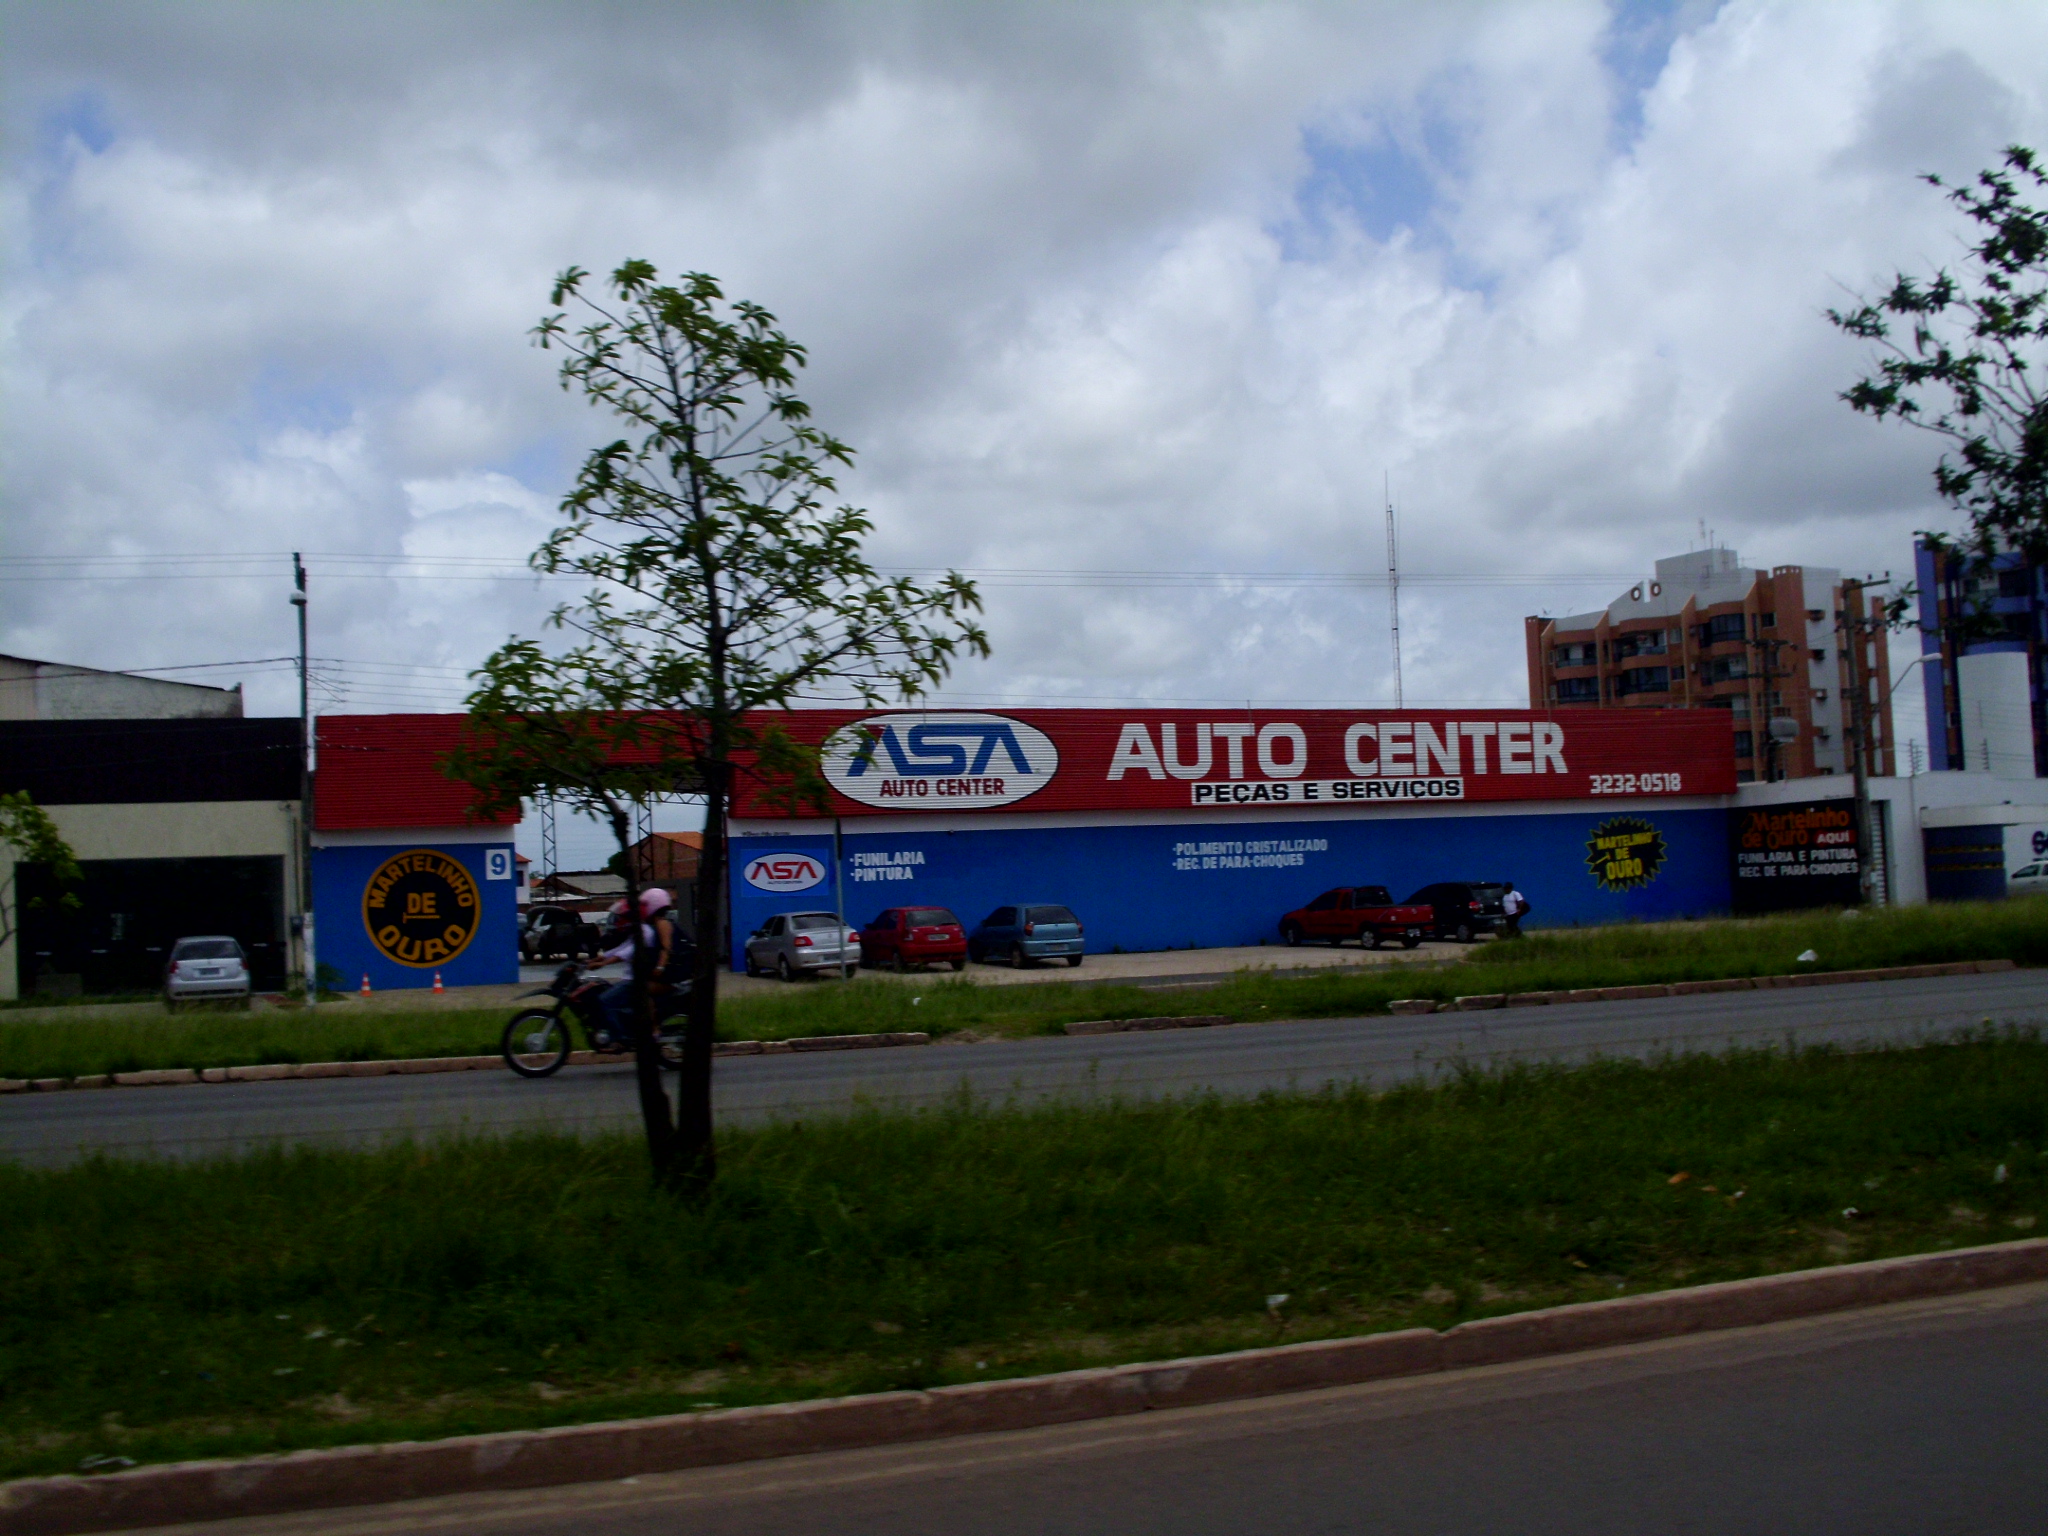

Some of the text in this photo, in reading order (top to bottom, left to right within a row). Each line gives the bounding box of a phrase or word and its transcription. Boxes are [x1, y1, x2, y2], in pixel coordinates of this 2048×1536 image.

[1106, 721, 1569, 781] AUTO CENTER
[880, 777, 1005, 798] AUTO CENTER
[1194, 779, 1461, 803] PEÇAS E SERVIÇOS
[1746, 806, 1850, 832] Martelinho
[1175, 838, 1329, 856] POLIMENTO CRISTALIZADO
[1737, 847, 1858, 864] FUNILARIA E PINTURA
[490, 853, 507, 876] 9
[751, 861, 818, 880] ASA
[1202, 856, 1218, 870] DE
[1606, 857, 1643, 880] OURO
[1763, 865, 1777, 877] DE
[369, 855, 474, 908] MARTELINHO
[406, 892, 437, 914] DE
[377, 924, 466, 961] OURO
